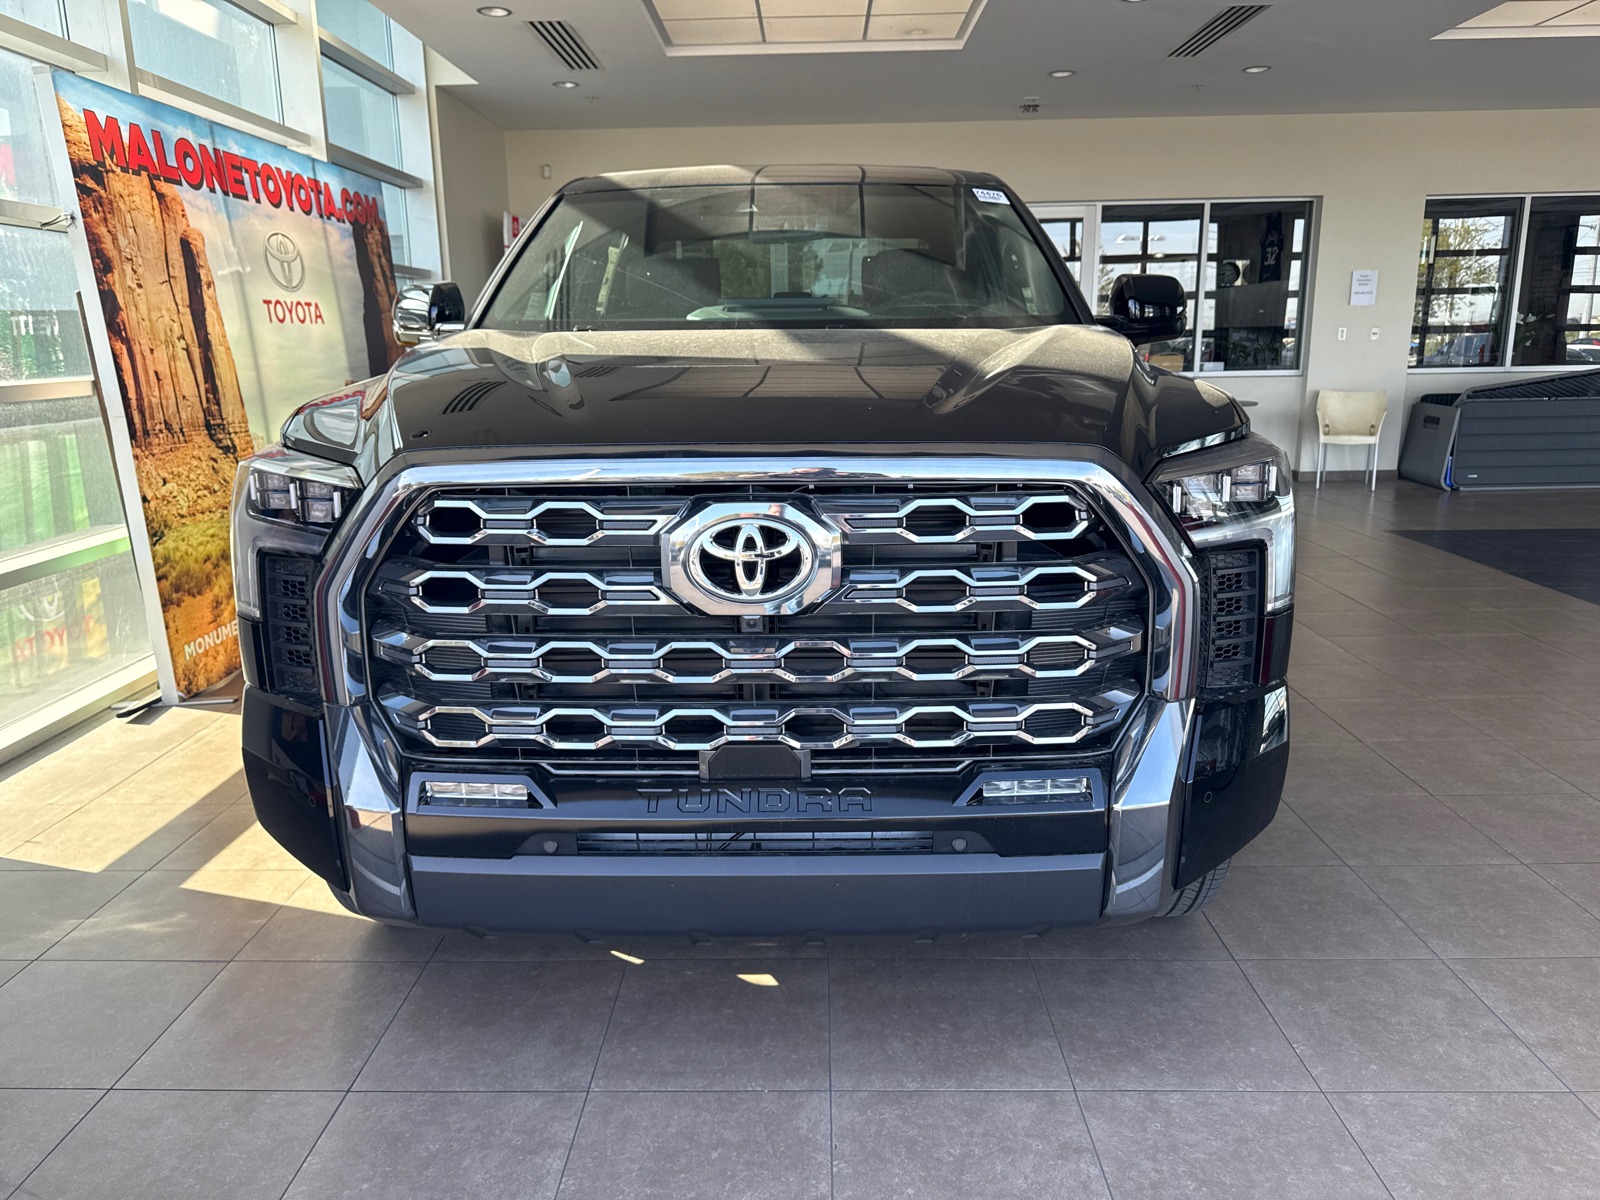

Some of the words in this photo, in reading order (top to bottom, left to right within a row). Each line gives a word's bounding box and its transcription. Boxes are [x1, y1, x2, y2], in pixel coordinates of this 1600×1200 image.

[83, 109, 379, 225] MALONETOYOTA.COM
[1264, 246, 1278, 265] 32
[263, 299, 325, 325] TOYOTA
[184, 619, 238, 662] MONUME
[636, 787, 873, 813] TUNDRA
